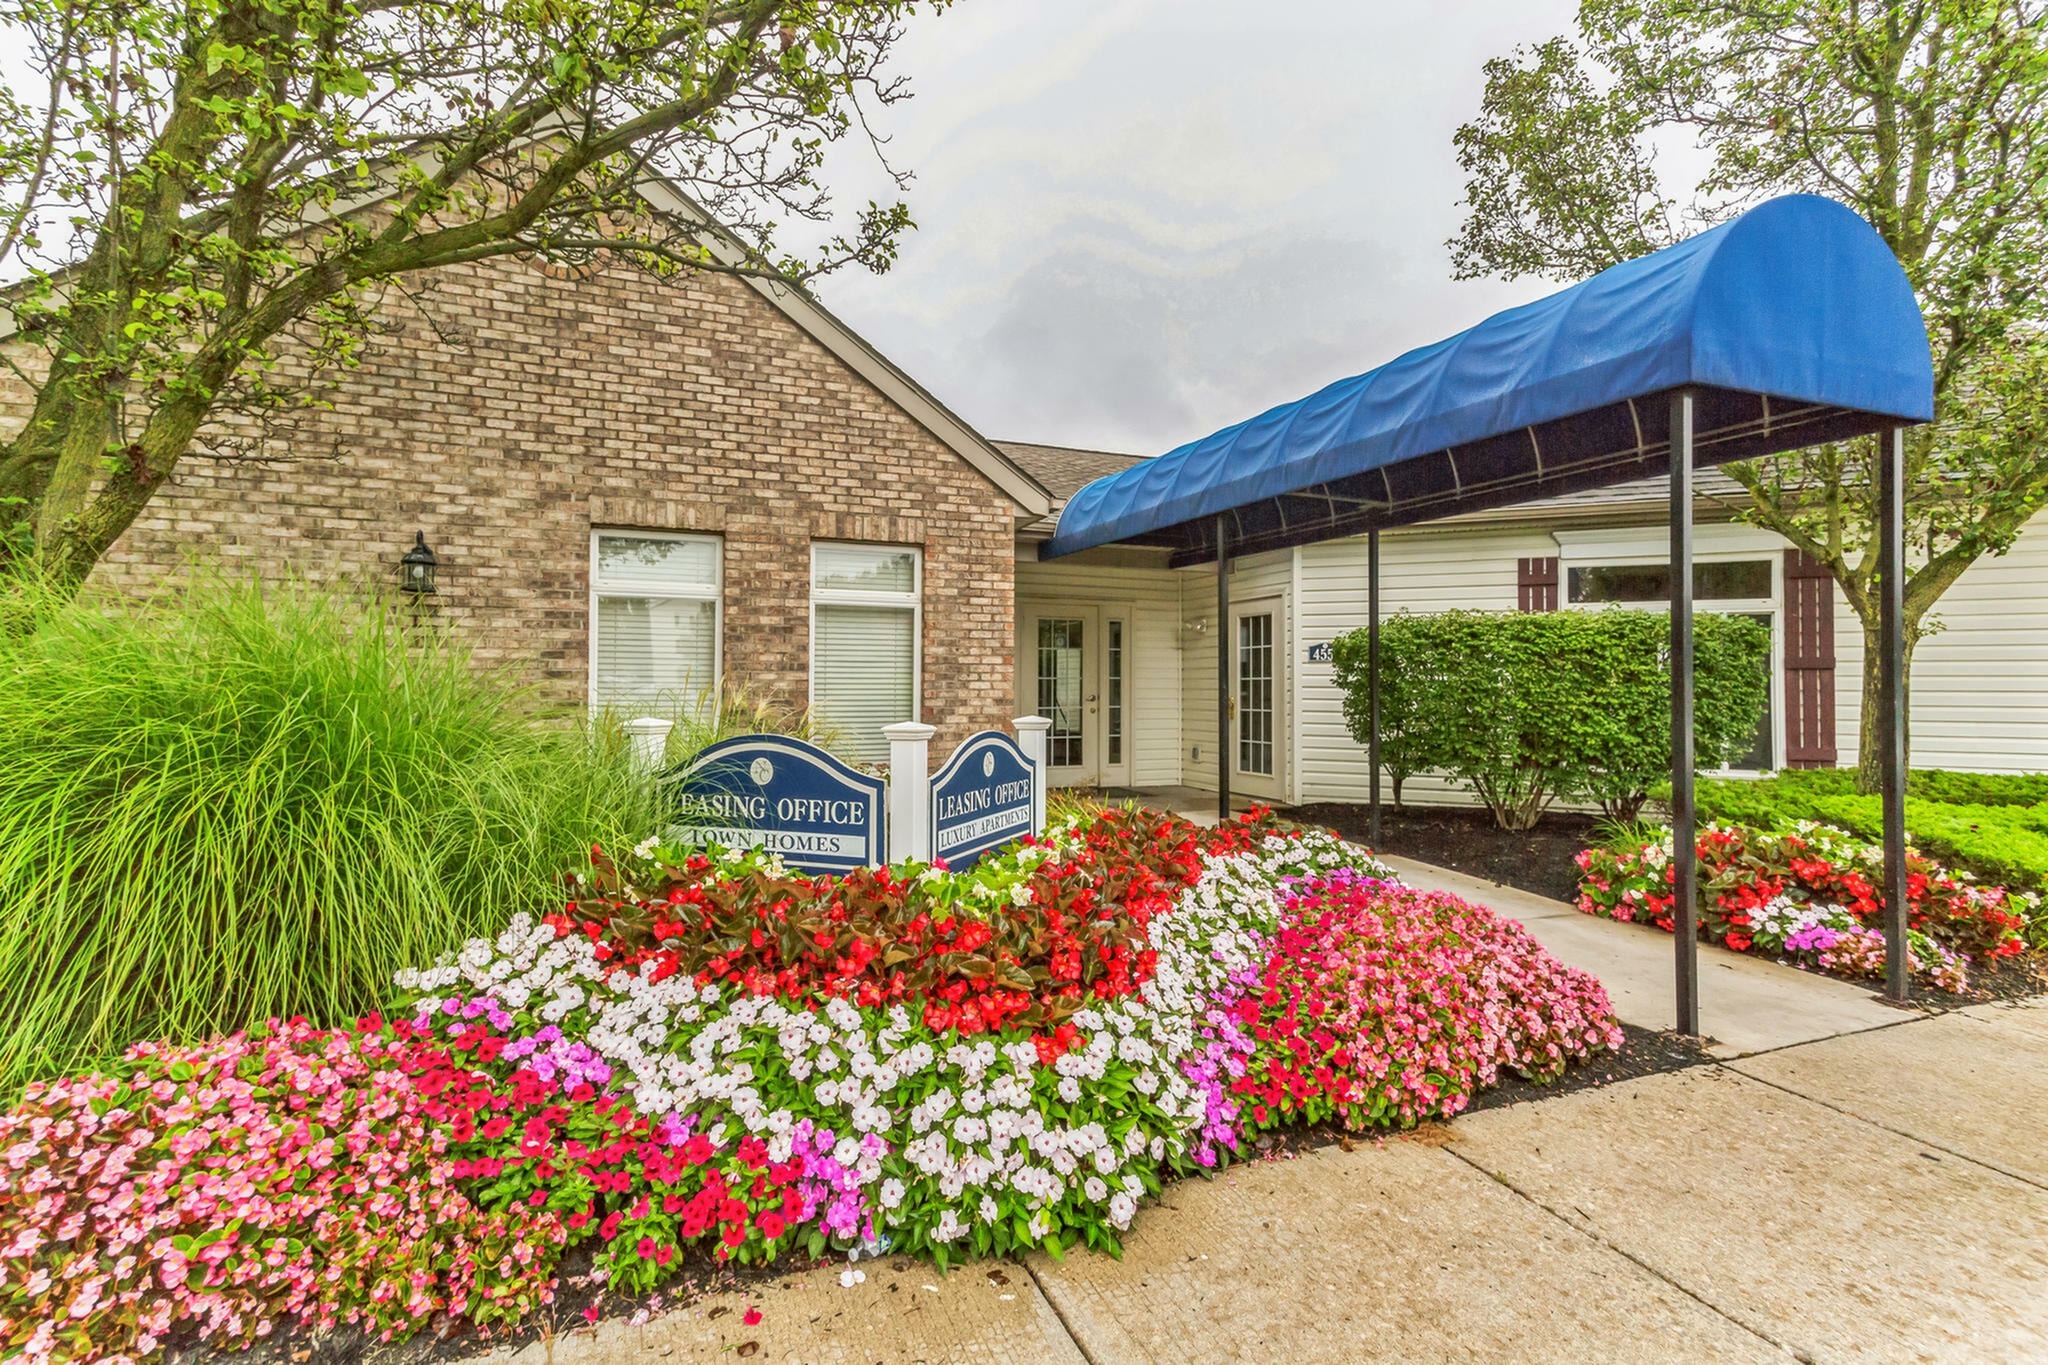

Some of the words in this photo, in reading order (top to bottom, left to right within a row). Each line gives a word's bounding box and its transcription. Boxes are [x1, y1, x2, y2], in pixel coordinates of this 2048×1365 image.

[776, 798, 865, 825] OFFICE
[939, 787, 991, 820] LEASING
[994, 778, 1030, 805] OFFICE
[691, 829, 752, 848] TOWN
[764, 833, 841, 853] HOMES
[940, 824, 976, 847] LUXURY
[980, 808, 1029, 831] APARTMENTS
